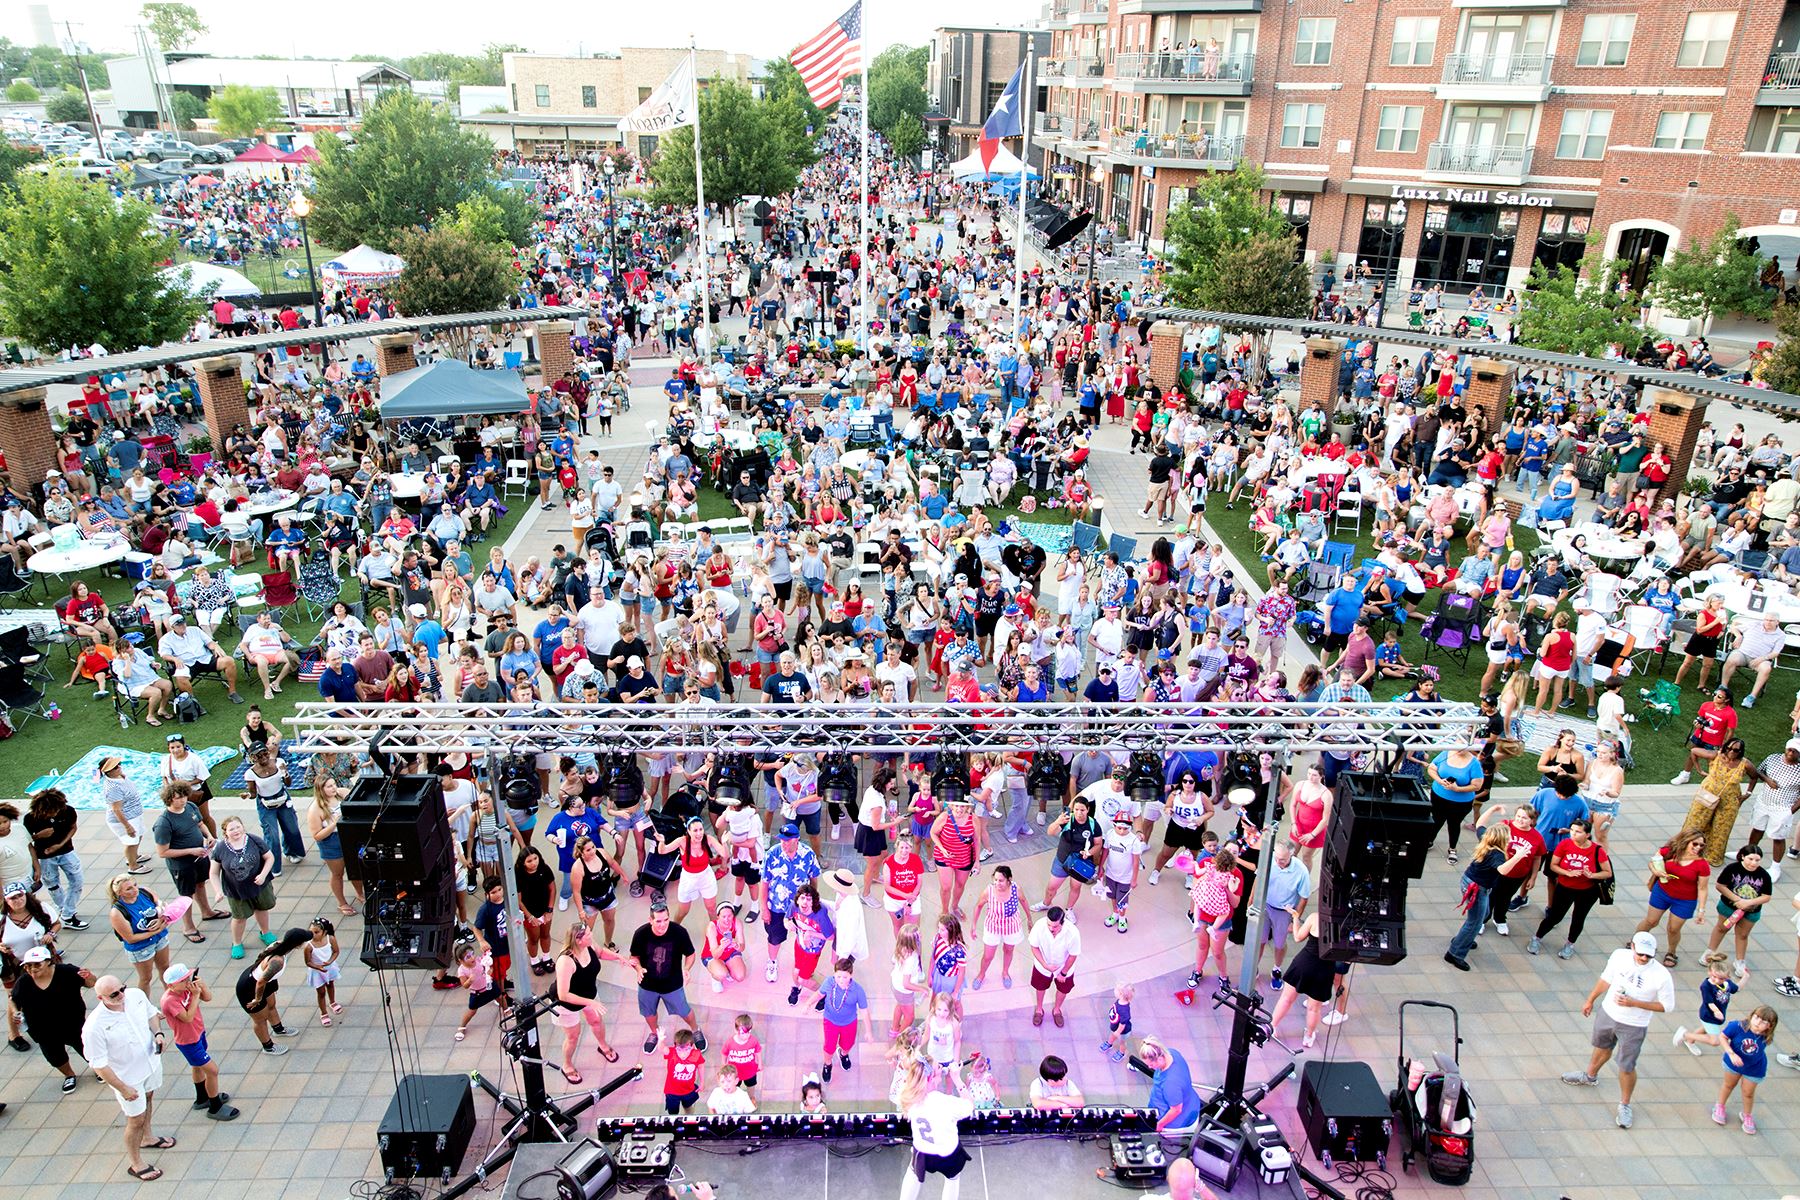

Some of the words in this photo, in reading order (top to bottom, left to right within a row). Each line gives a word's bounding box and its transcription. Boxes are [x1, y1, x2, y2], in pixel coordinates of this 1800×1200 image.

[1391, 185, 1440, 200] Luxx
[1446, 188, 1488, 204] Nail
[1494, 191, 1553, 207] Salon
[982, 598, 997, 606] true
[981, 605, 997, 614] love
[1235, 662, 1246, 671] Dr
[1175, 806, 1200, 817] USA
[4, 882, 25, 895] USA
[916, 1117, 934, 1144] 2
